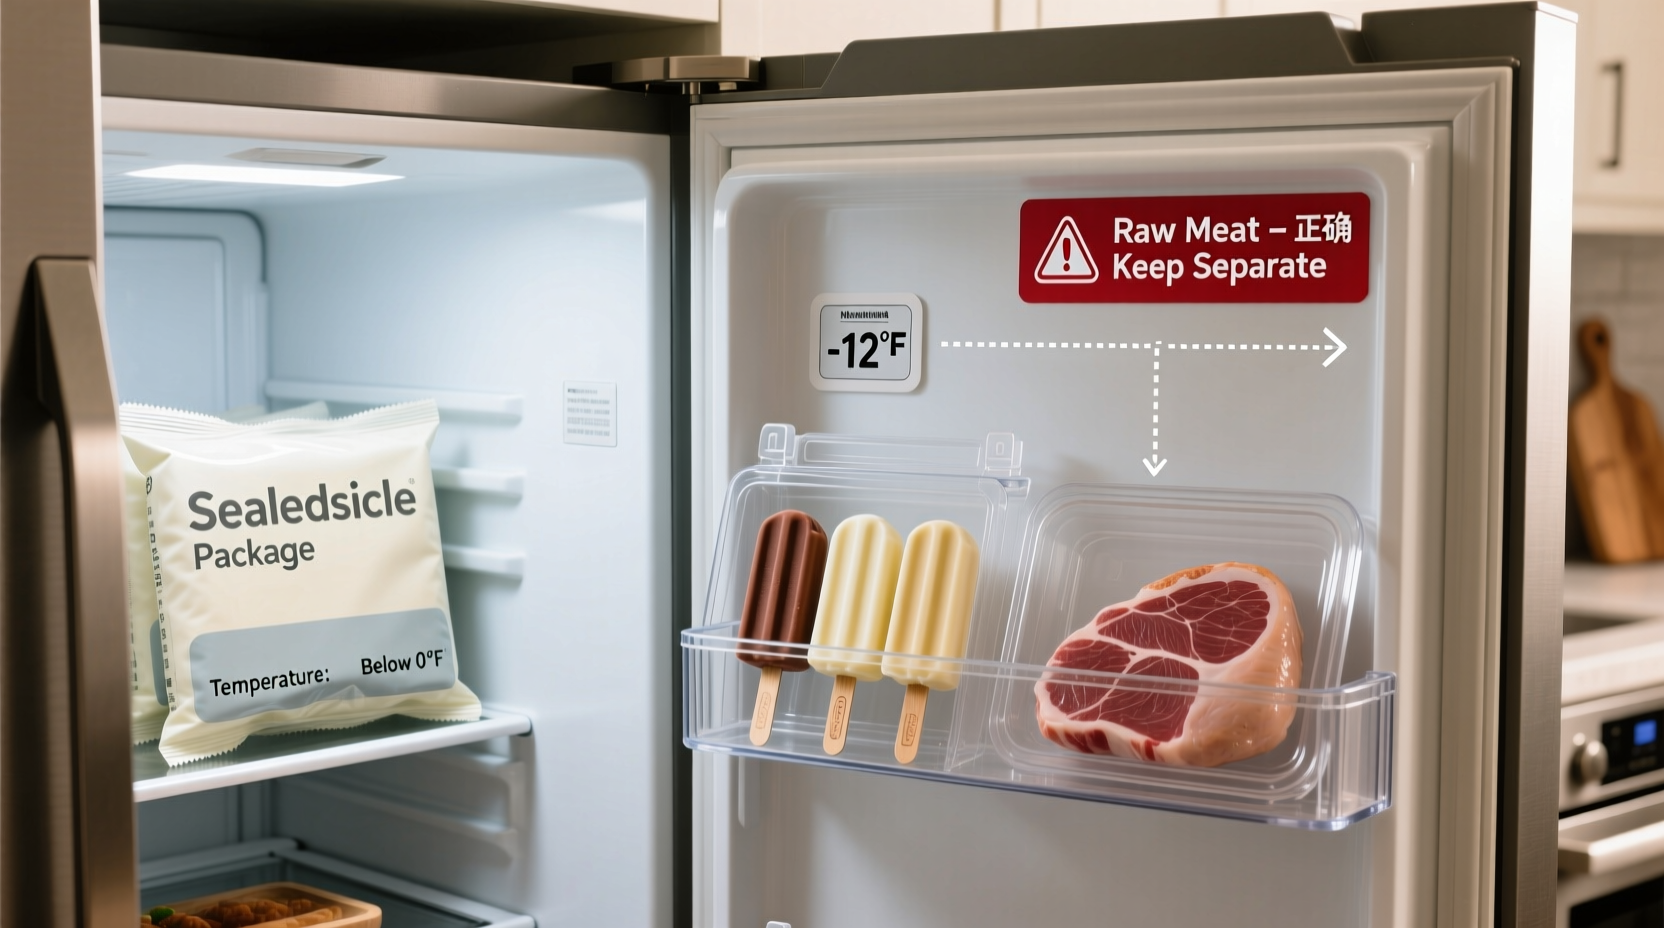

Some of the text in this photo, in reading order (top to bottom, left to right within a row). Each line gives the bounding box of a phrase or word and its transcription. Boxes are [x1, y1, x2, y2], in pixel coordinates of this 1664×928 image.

[1113, 217, 1177, 244] Raw
[1185, 216, 1260, 243] Meat
[1294, 211, 1353, 244] 正确
[1113, 252, 1327, 287] Keep Separate
[827, 330, 907, 369] -12°F
[187, 479, 417, 531] Sealedsicle
[193, 539, 315, 571] Package
[209, 665, 330, 698] Temperature:
[360, 655, 412, 676] Below
